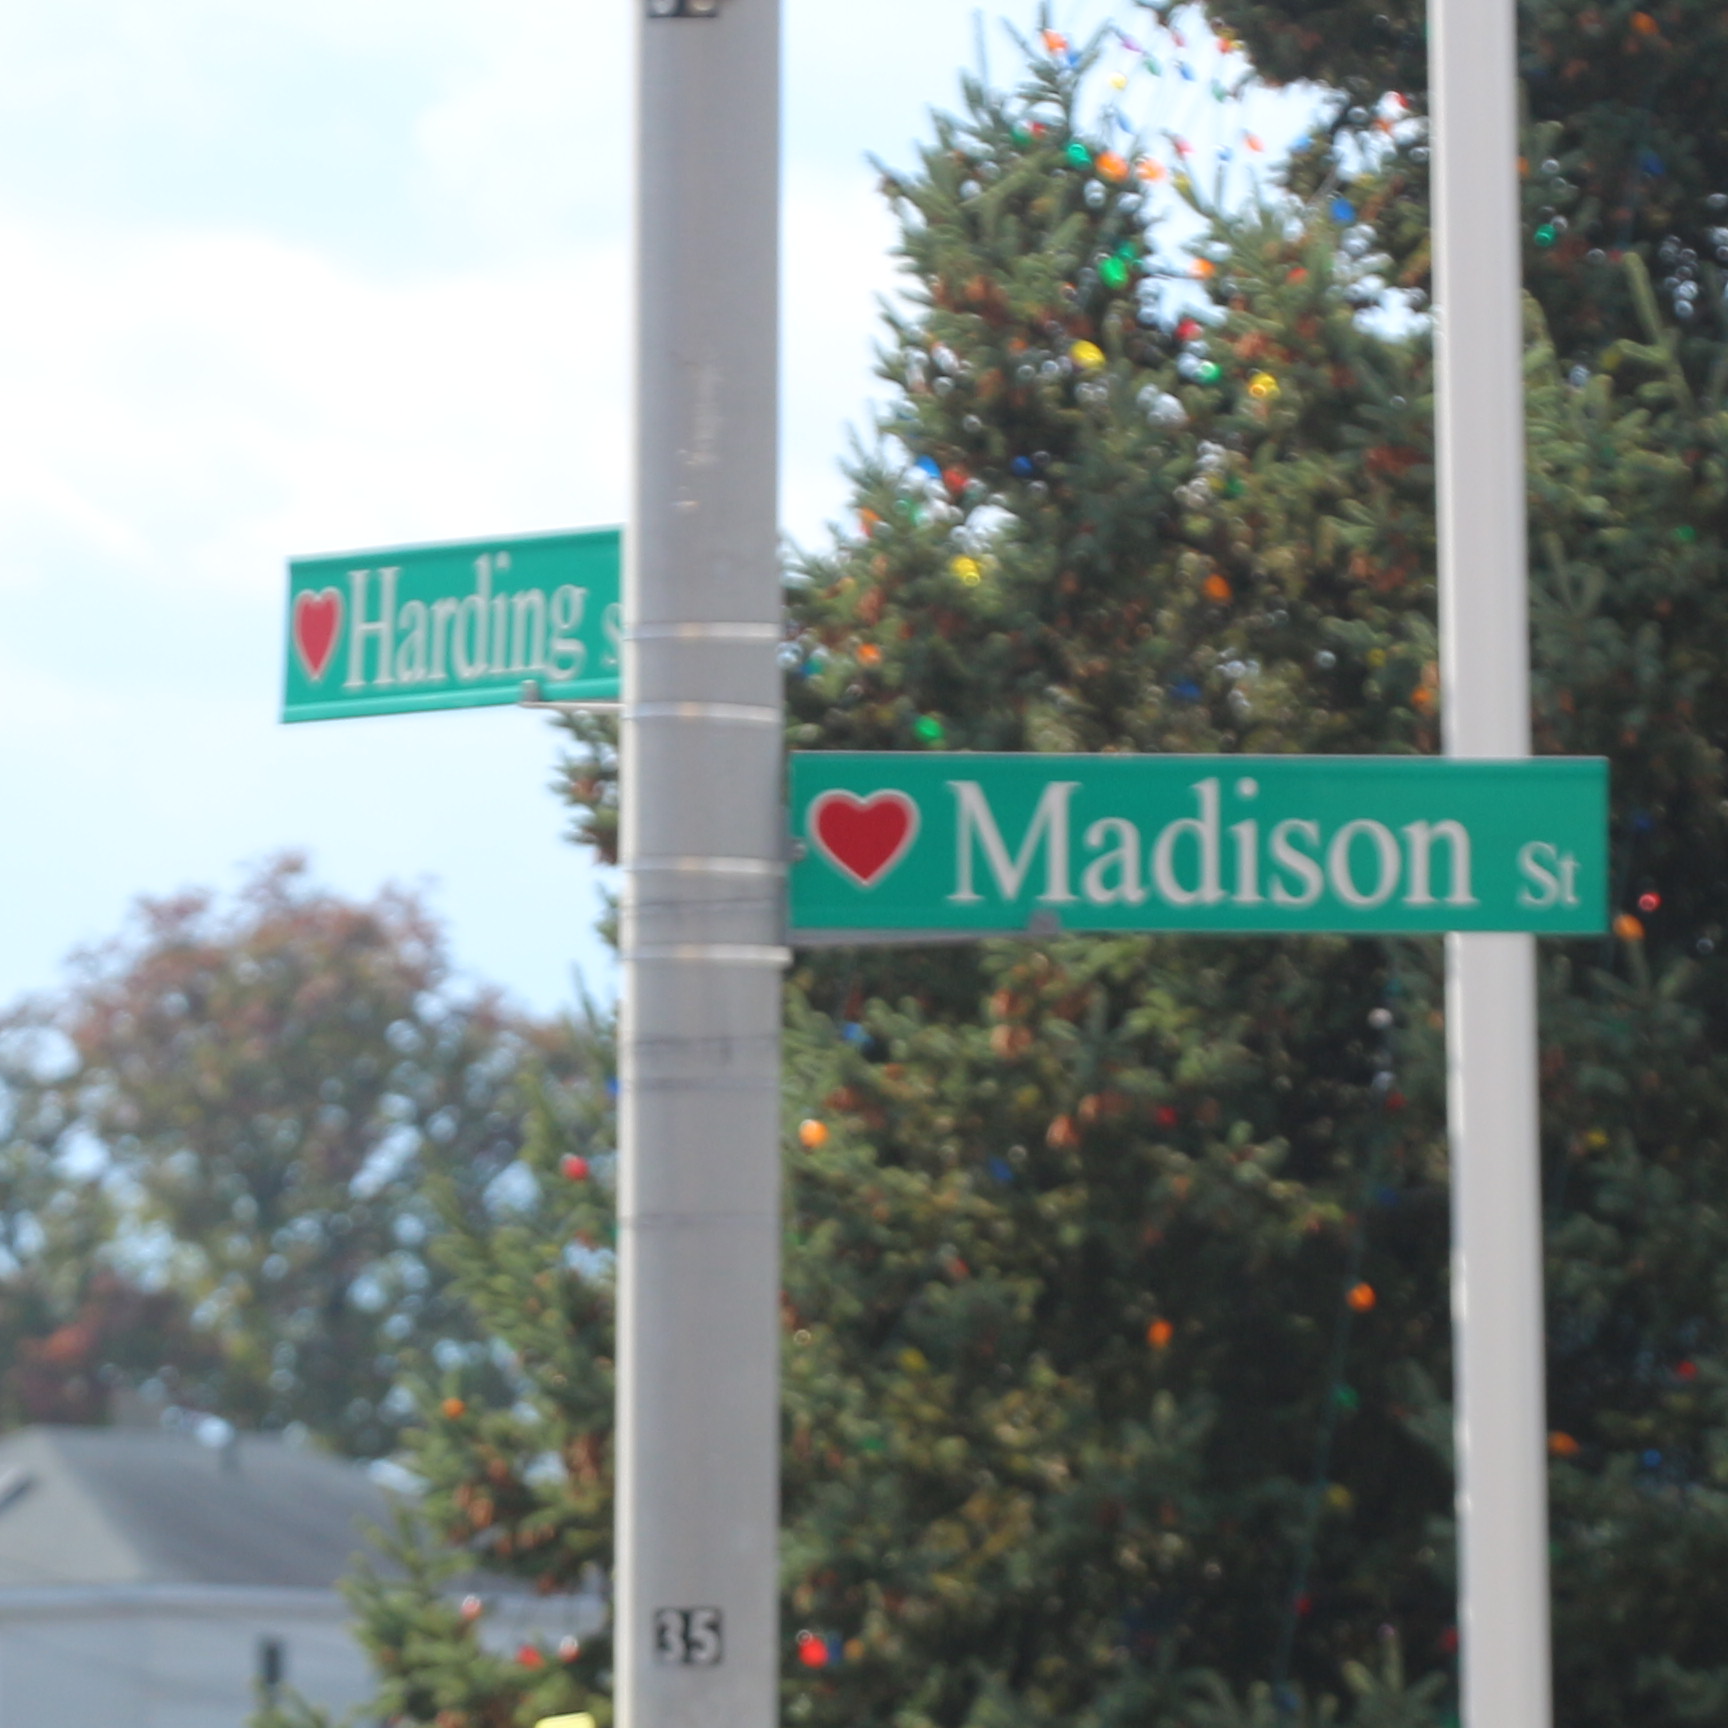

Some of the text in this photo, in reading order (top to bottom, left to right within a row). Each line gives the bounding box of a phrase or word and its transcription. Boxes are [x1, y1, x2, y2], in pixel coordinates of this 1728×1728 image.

[342, 551, 622, 682] Harding S
[946, 776, 1581, 906] Madison St
[656, 1608, 720, 1662] 35
